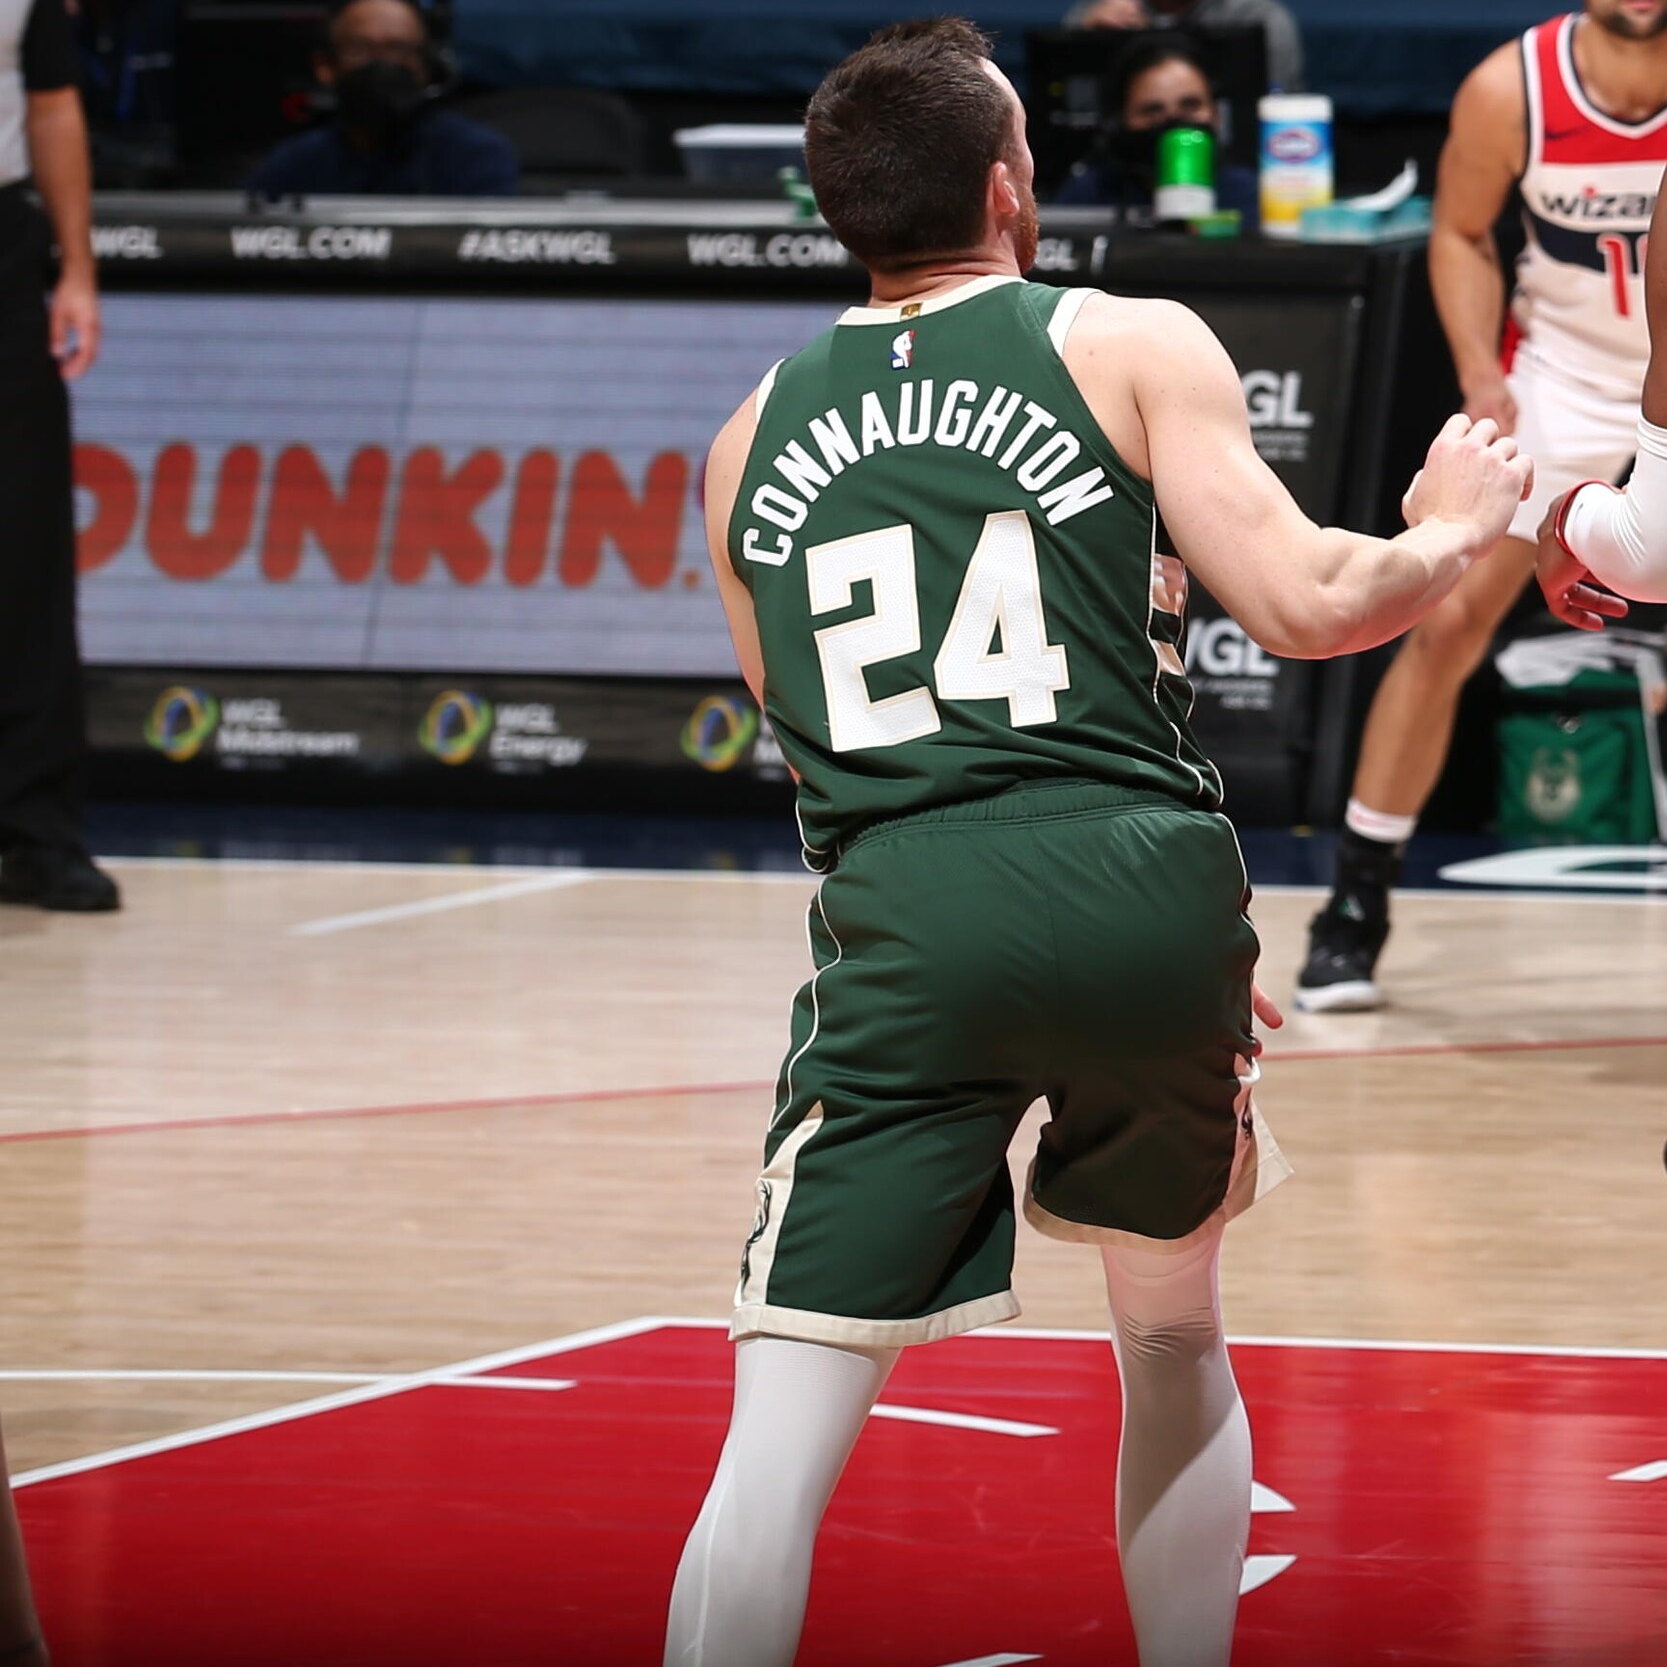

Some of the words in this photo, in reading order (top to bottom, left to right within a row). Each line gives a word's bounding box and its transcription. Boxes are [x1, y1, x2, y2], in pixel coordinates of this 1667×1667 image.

[231, 227, 392, 260] WGL.COM
[1541, 184, 1657, 218] wiza
[1597, 233, 1649, 319] 1
[1247, 369, 1313, 428] GL
[73, 441, 704, 590] DUNKIN
[741, 378, 1114, 567] CONNAUGHTON
[804, 509, 1070, 754] 24
